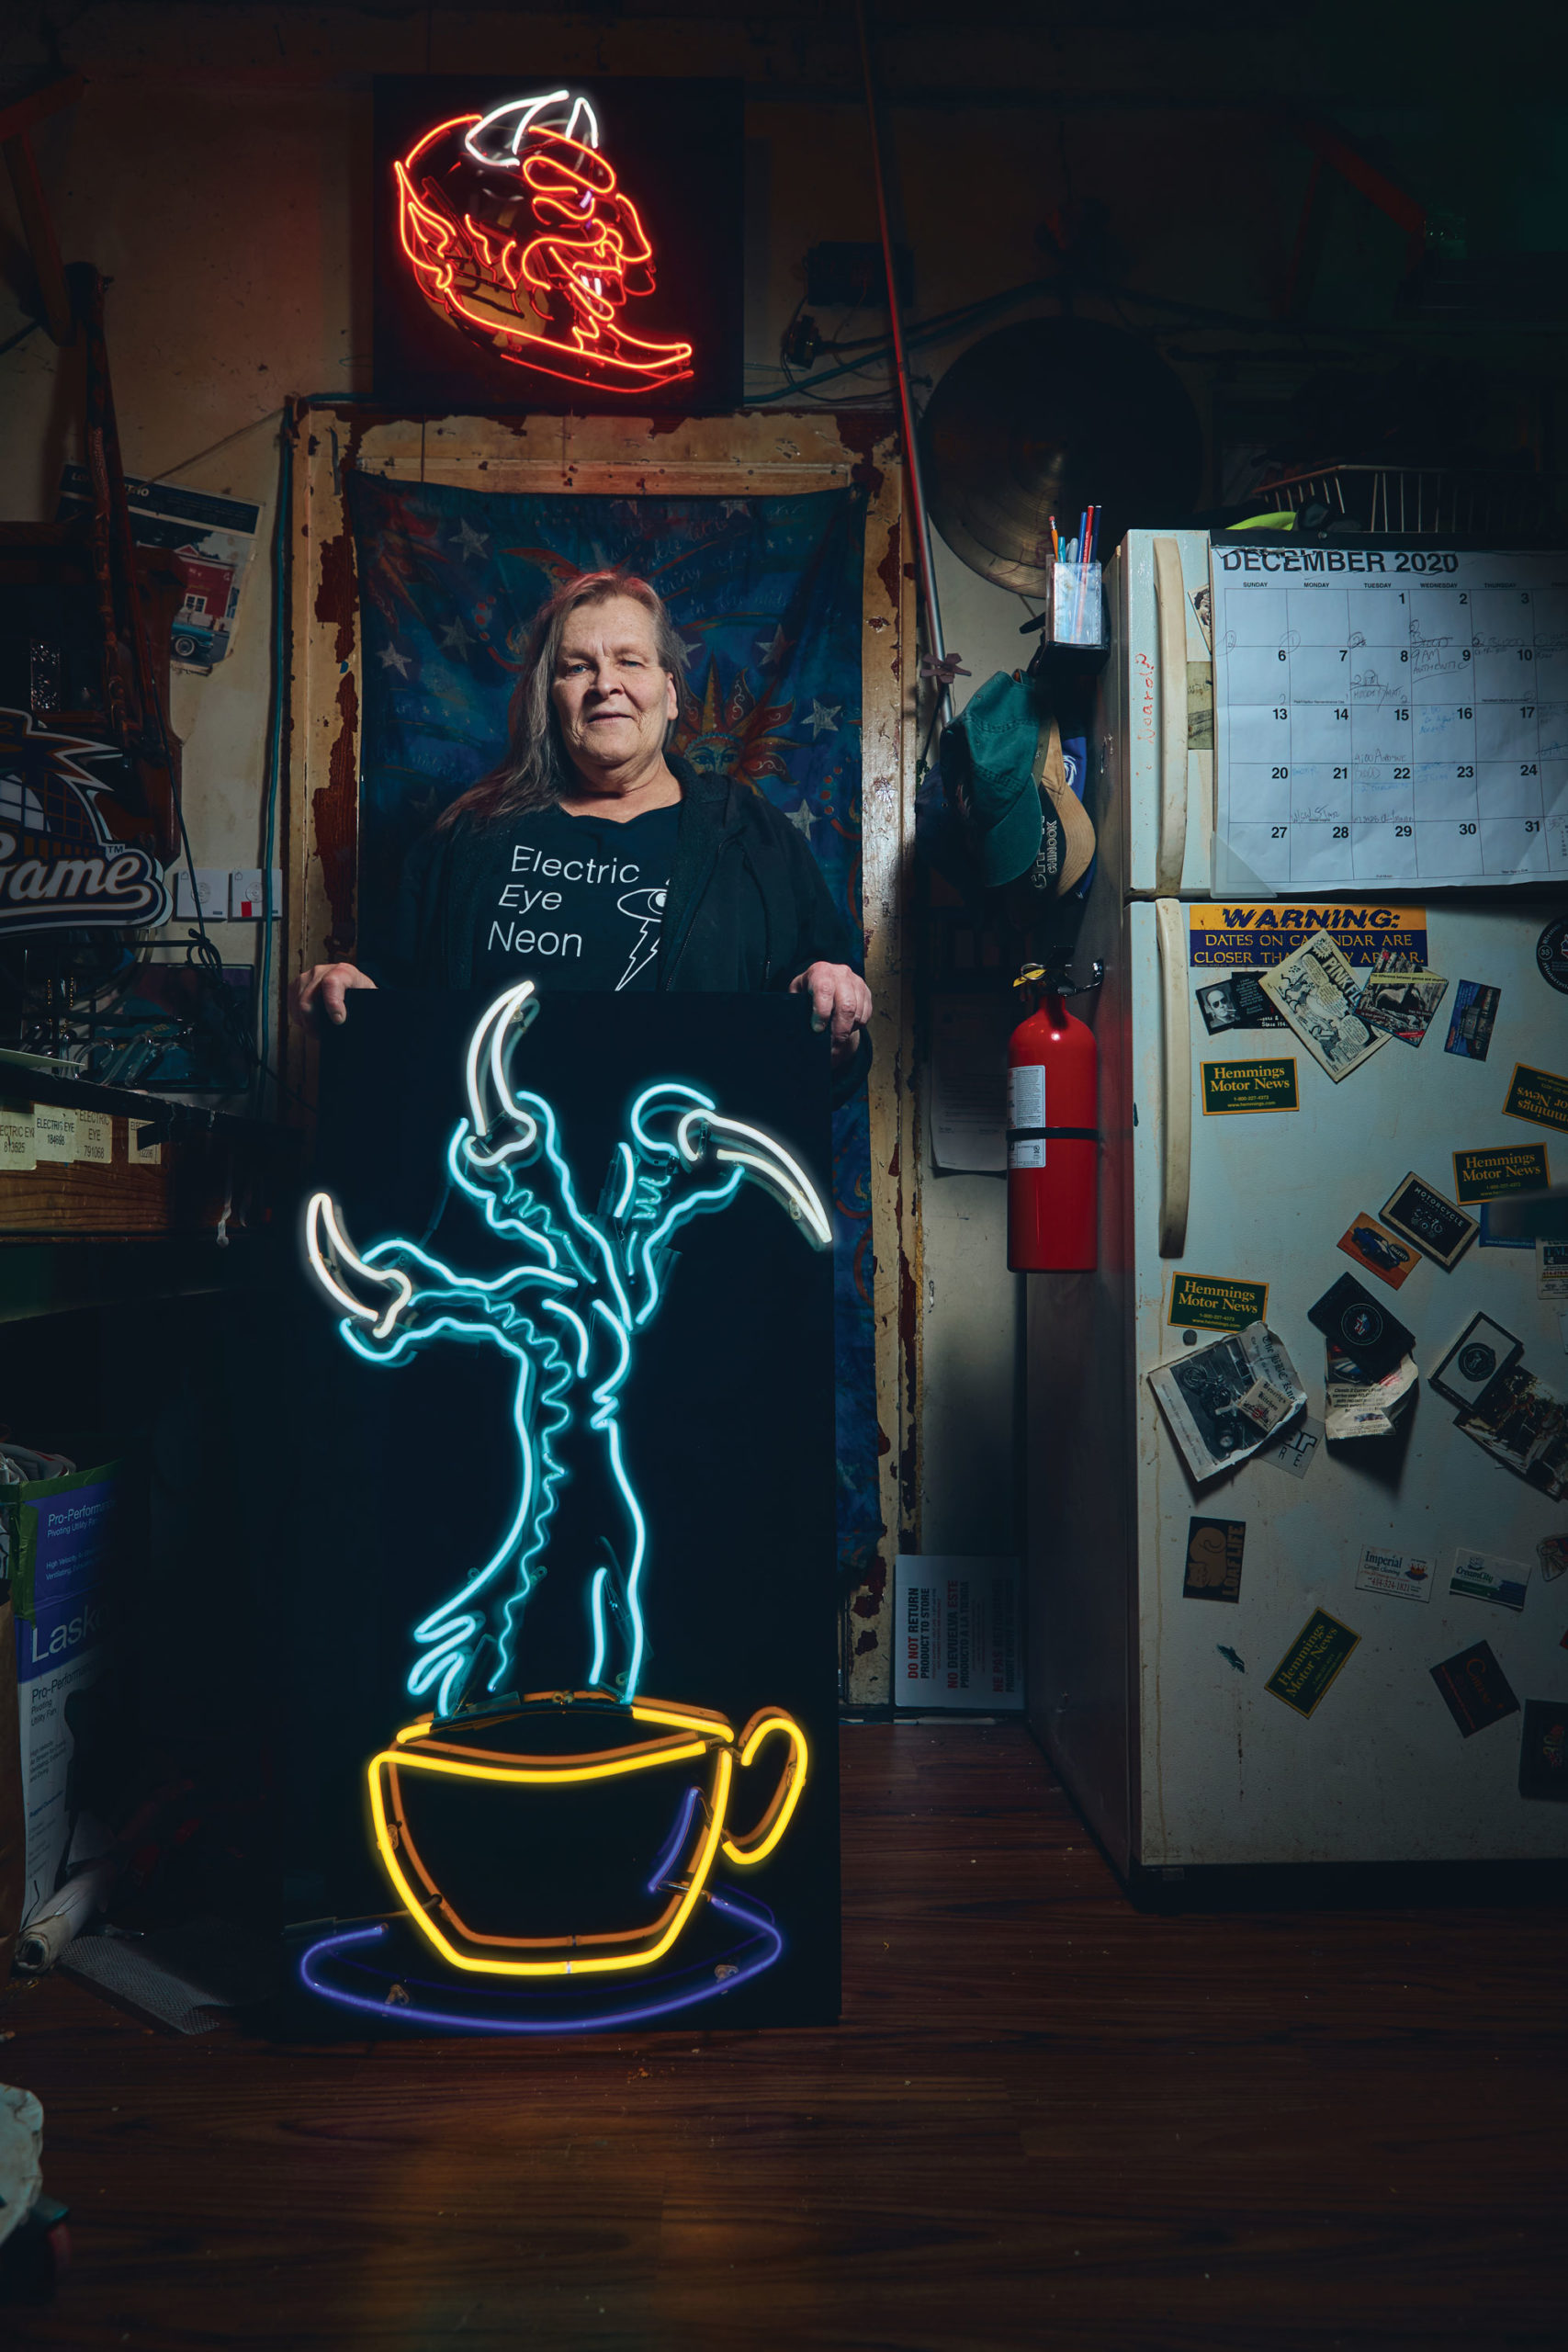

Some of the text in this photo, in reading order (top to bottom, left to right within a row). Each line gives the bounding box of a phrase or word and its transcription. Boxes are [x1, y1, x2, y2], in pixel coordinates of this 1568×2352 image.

[1223, 549, 1459, 573] DECEMBER 2020
[1399, 594, 1529, 605] 1 2 3
[1278, 650, 1532, 662] 6 7 8 9 10
[1272, 708, 1288, 719] 13
[1334, 708, 1348, 720] 14
[1394, 709, 1409, 720] 15
[1457, 707, 1472, 719] 16
[1519, 707, 1535, 718] 17
[1271, 767, 1288, 779] 20
[1333, 767, 1348, 779] 21
[1393, 768, 1410, 779] 22
[1457, 766, 1473, 778] 23
[1520, 764, 1538, 776] 24
[1271, 820, 1540, 838] 27 28 29 30 31
[1046, 820, 1057, 874] CHINOOK
[511, 844, 640, 884] Electric
[498, 884, 562, 914] Eye
[1223, 909, 1401, 929] WARNING:
[488, 921, 582, 957] Neon
[1205, 934, 1413, 946] DATES ON CANDAR ARE
[1194, 952, 1253, 964] CLOSER
[1322, 956, 1350, 992] PINK
[1213, 1065, 1285, 1080] Hemmings
[1211, 1078, 1290, 1092] Motor News
[1517, 1087, 1551, 1107] News
[37, 1117, 75, 1133] ELECTRIC EYE
[80, 1110, 110, 1125] ELECTRIC
[88, 1128, 101, 1141] EYE
[1465, 1153, 1536, 1169] Hemmings
[1462, 1165, 1541, 1182] Motor News
[1414, 1185, 1464, 1228] MOTORCYCLE
[1184, 1280, 1256, 1302] Hemmings
[1178, 1293, 1258, 1314] Motor News
[47, 1524, 71, 1538] Pivoting
[72, 1521, 87, 1532] Utility
[46, 1558, 59, 1569] High
[1222, 1525, 1245, 1596] LOAF LIFE
[1365, 1552, 1403, 1569] Imperial
[1456, 1566, 1495, 1583] CreamCity
[960, 1616, 969, 1628] LA
[908, 1588, 919, 1679] DO NOT RETURN
[920, 1588, 930, 1679] PRODUCT TO STORE
[947, 1580, 958, 1689] NO DEVUELVA ESTE
[960, 1638, 969, 1689] PRODUCTO
[1277, 1623, 1325, 1688] Hemmings
[1285, 1627, 1338, 1699] Motor News
[30, 1699, 52, 1714] Pivoting
[30, 1708, 57, 1727] Utility Fan
